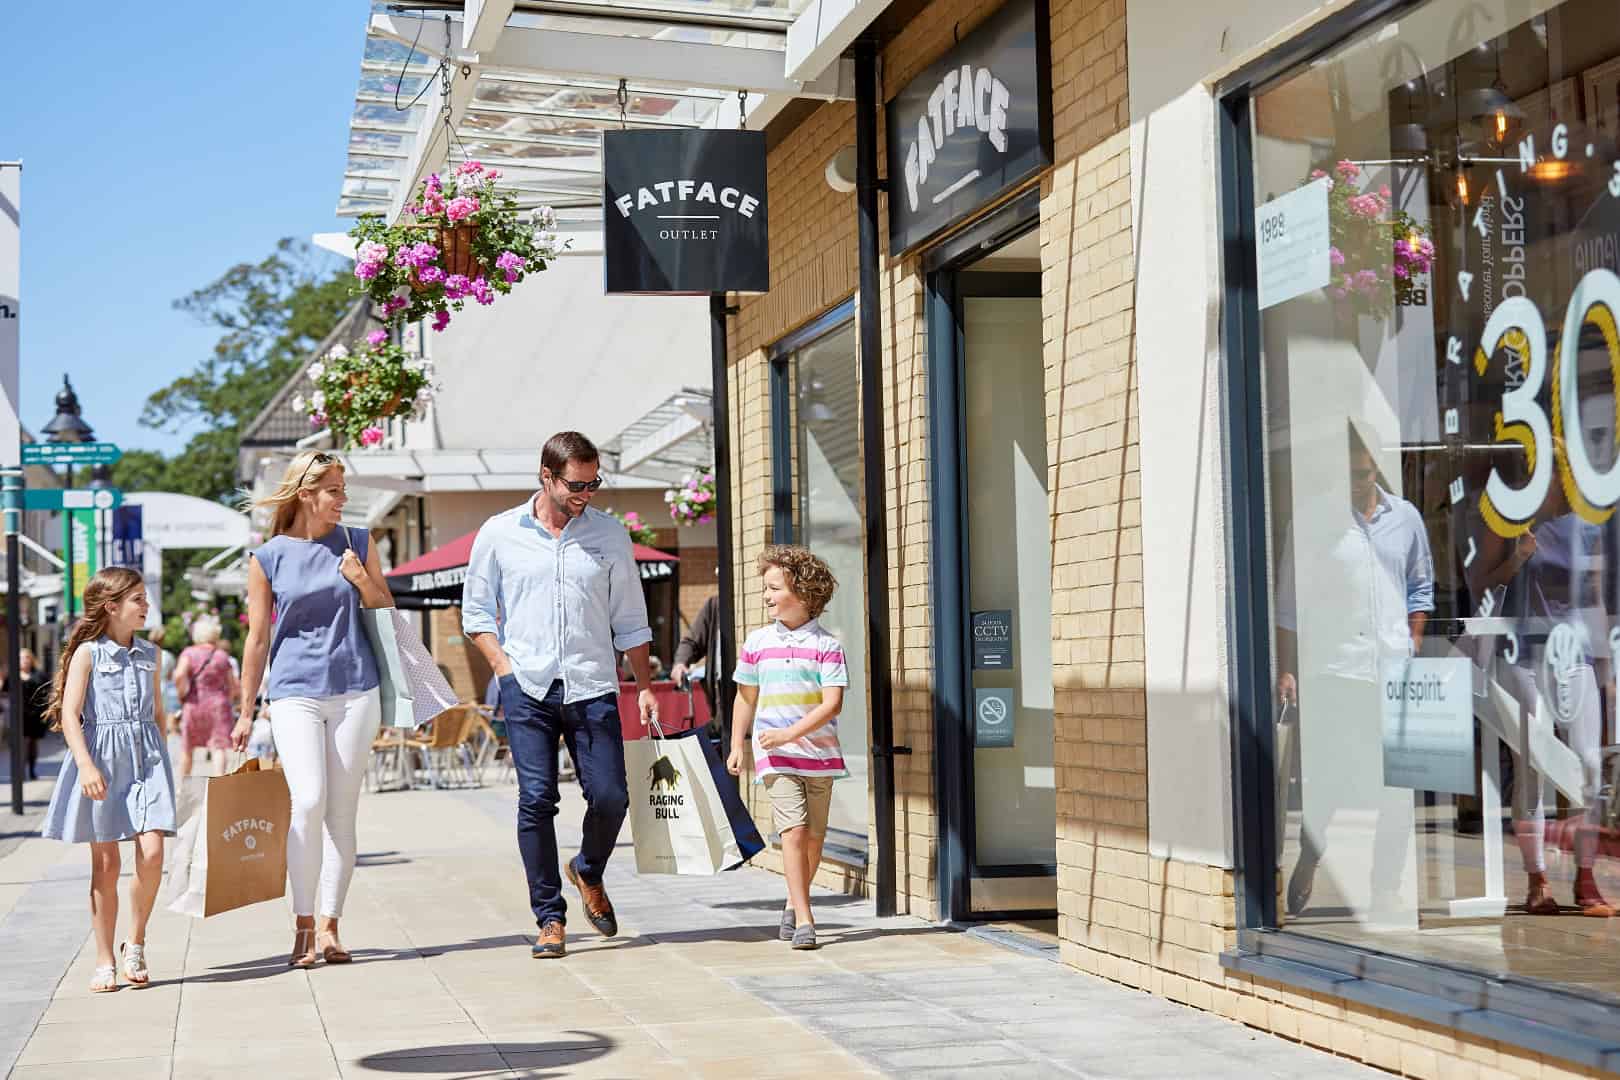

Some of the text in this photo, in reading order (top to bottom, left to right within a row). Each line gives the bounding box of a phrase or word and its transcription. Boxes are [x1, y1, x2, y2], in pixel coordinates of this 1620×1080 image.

[905, 64, 1010, 213] FATFACE
[614, 180, 760, 218] FATFACE
[659, 230, 719, 240] OUTLET
[1260, 211, 1286, 245] 1988
[1477, 268, 1620, 536] 30
[974, 625, 1009, 637] CCTV
[1386, 680, 1407, 701] our
[649, 795, 684, 806] RAGING
[655, 808, 680, 819] BULL
[223, 818, 274, 842] FATFACE
